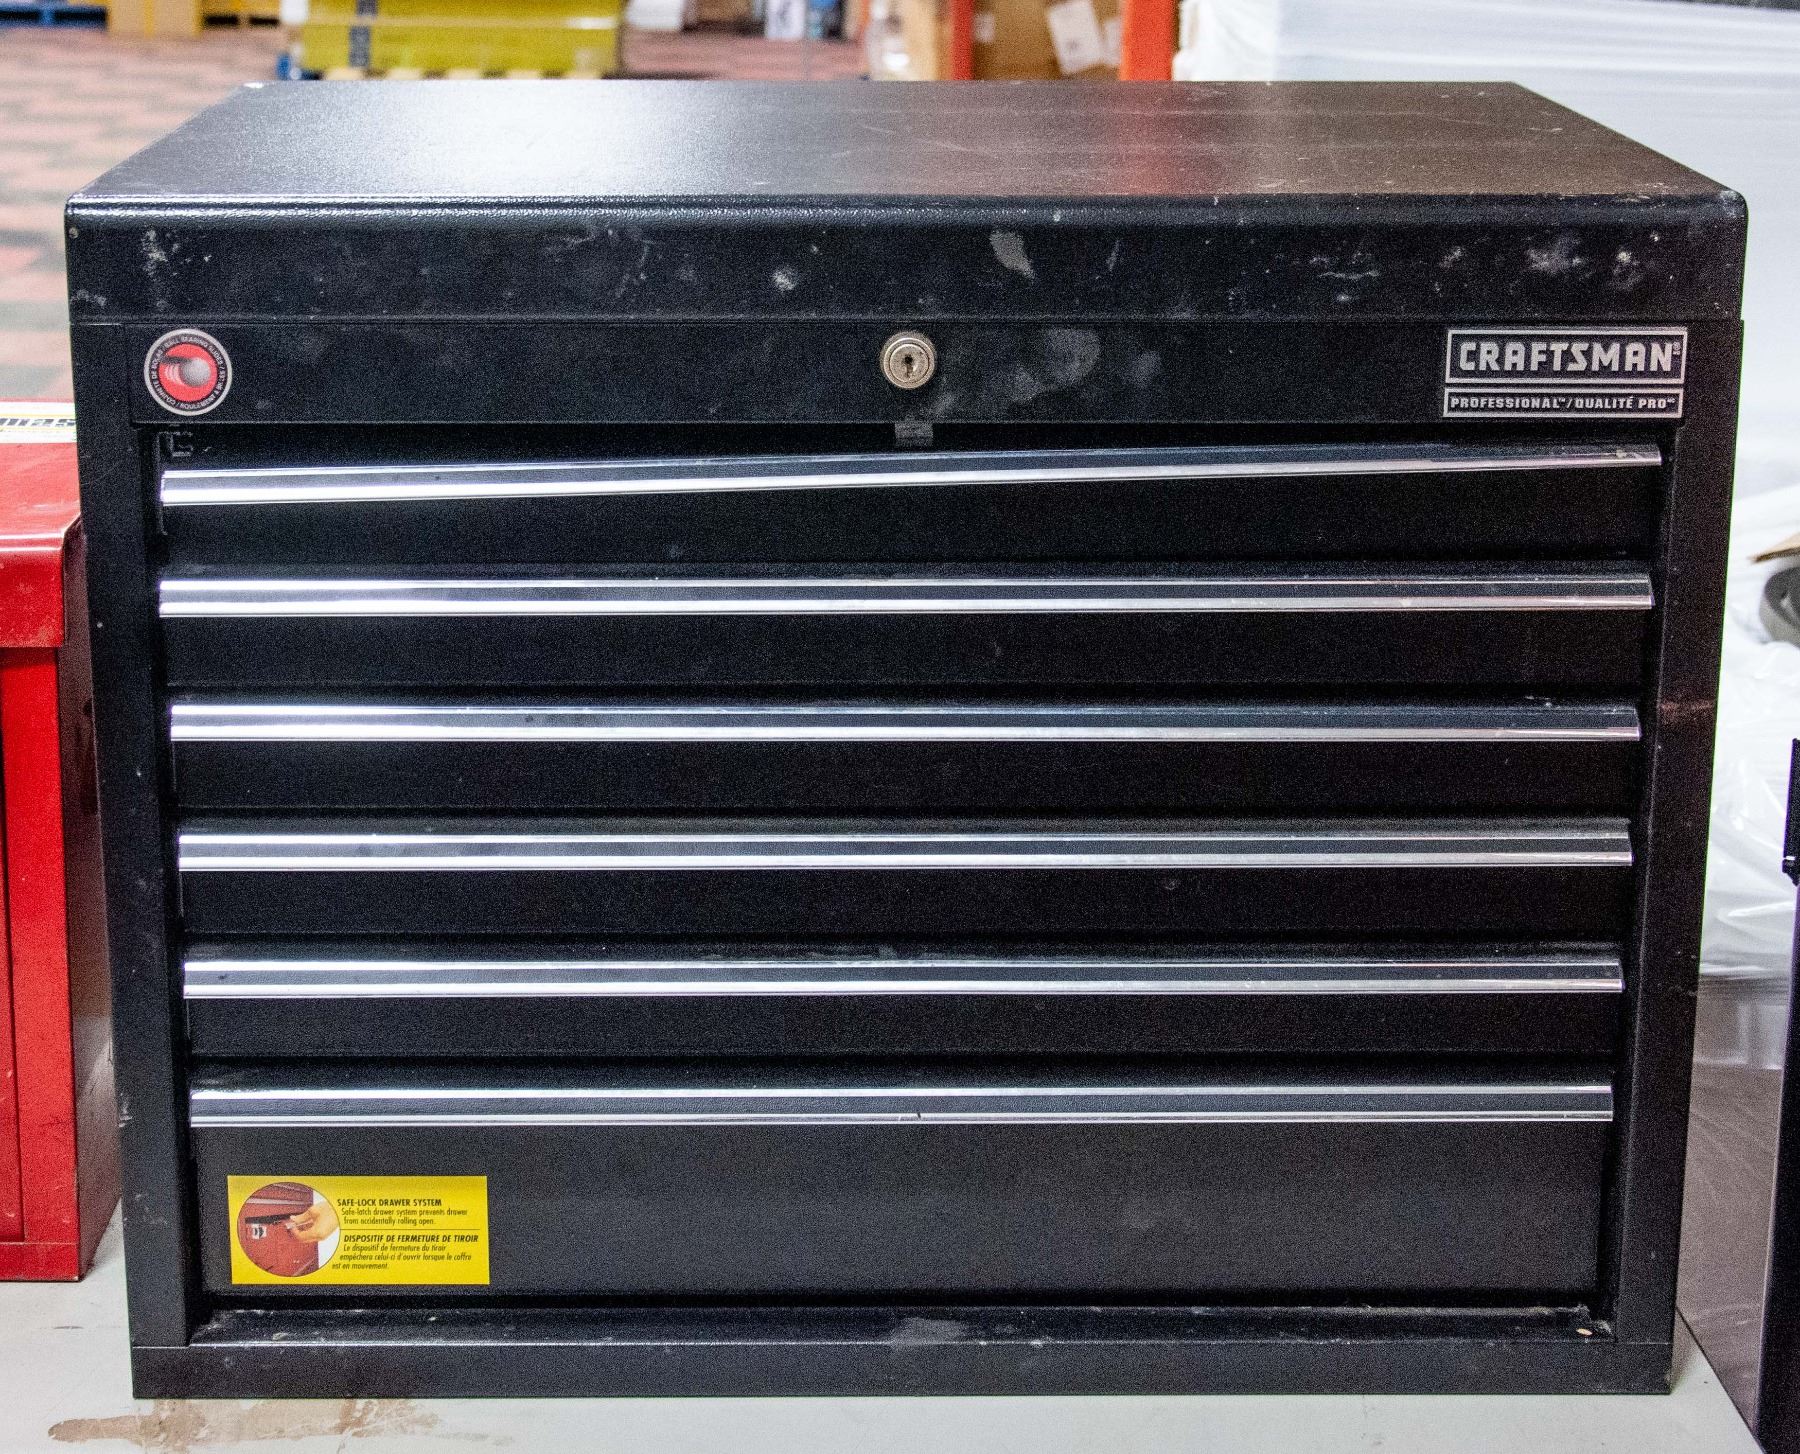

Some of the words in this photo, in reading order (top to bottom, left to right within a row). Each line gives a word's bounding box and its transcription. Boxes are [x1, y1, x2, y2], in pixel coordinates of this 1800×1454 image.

[337, 1198, 376, 1206] SAFE-LOCK
[379, 1198, 410, 1206] DRAWER
[413, 1198, 442, 1206] SYSTEM
[341, 1207, 371, 1216] Safe-latch
[373, 1207, 394, 1215] drawer
[396, 1208, 417, 1217] system
[419, 1208, 445, 1217] prevents
[447, 1207, 468, 1216] drawer
[343, 1216, 358, 1224] from
[361, 1216, 395, 1226] accidentally
[398, 1216, 417, 1226] rolling
[344, 1234, 384, 1242] DISPOSITIF
[386, 1234, 395, 1242] DE
[397, 1234, 439, 1242] FERMETURE
[442, 1234, 451, 1242] DE
[454, 1234, 479, 1242] TIROIR
[343, 1243, 350, 1251] Le
[352, 1243, 379, 1254] dispositif
[380, 1243, 388, 1251] de
[390, 1243, 421, 1251] fermeture
[422, 1243, 430, 1251] du
[423, 1252, 445, 1262] lorsque
[446, 1252, 453, 1260] le
[454, 1252, 472, 1261] coffre
